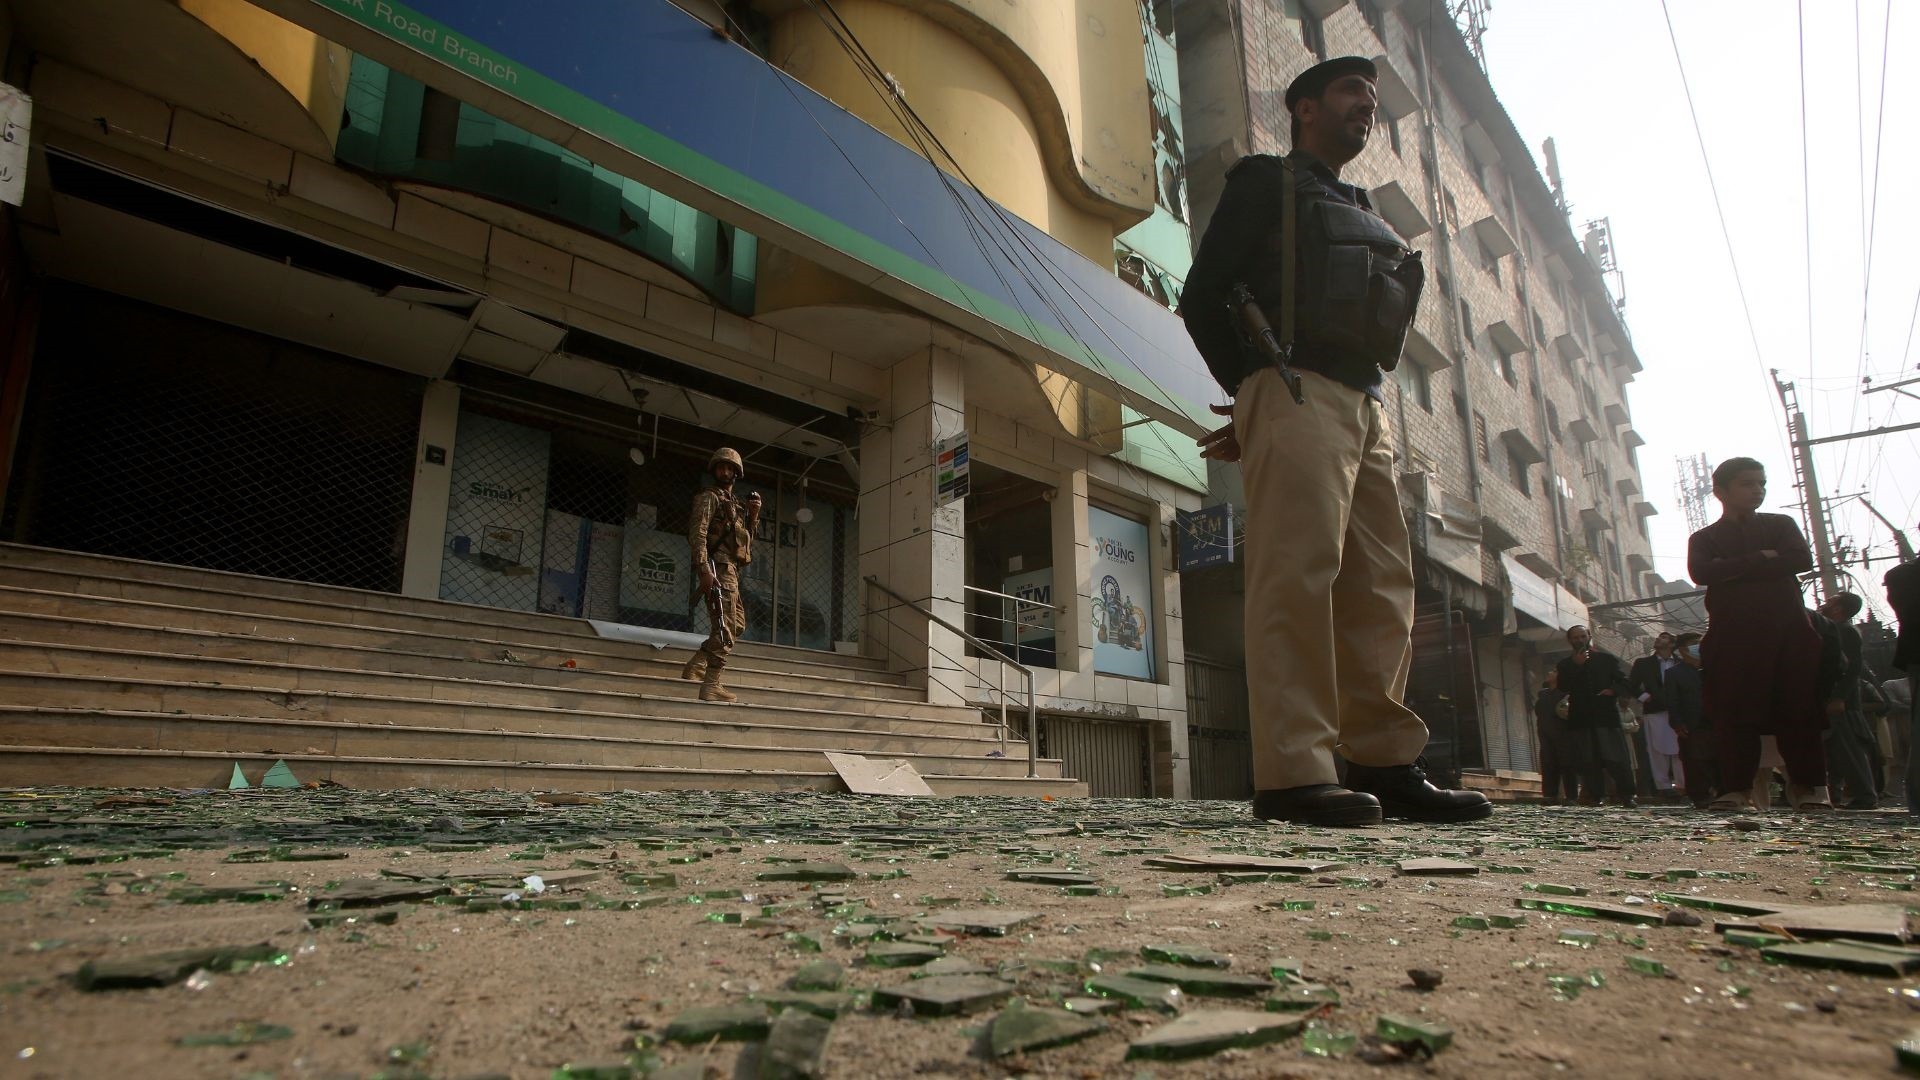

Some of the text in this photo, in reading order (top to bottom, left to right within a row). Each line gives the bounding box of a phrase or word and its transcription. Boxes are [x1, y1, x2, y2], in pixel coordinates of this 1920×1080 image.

[374, 1, 437, 46] Road
[443, 34, 518, 85] Branch
[1187, 516, 1223, 537] ATM
[639, 568, 675, 582] MCB
[1012, 585, 1052, 611] ATM
